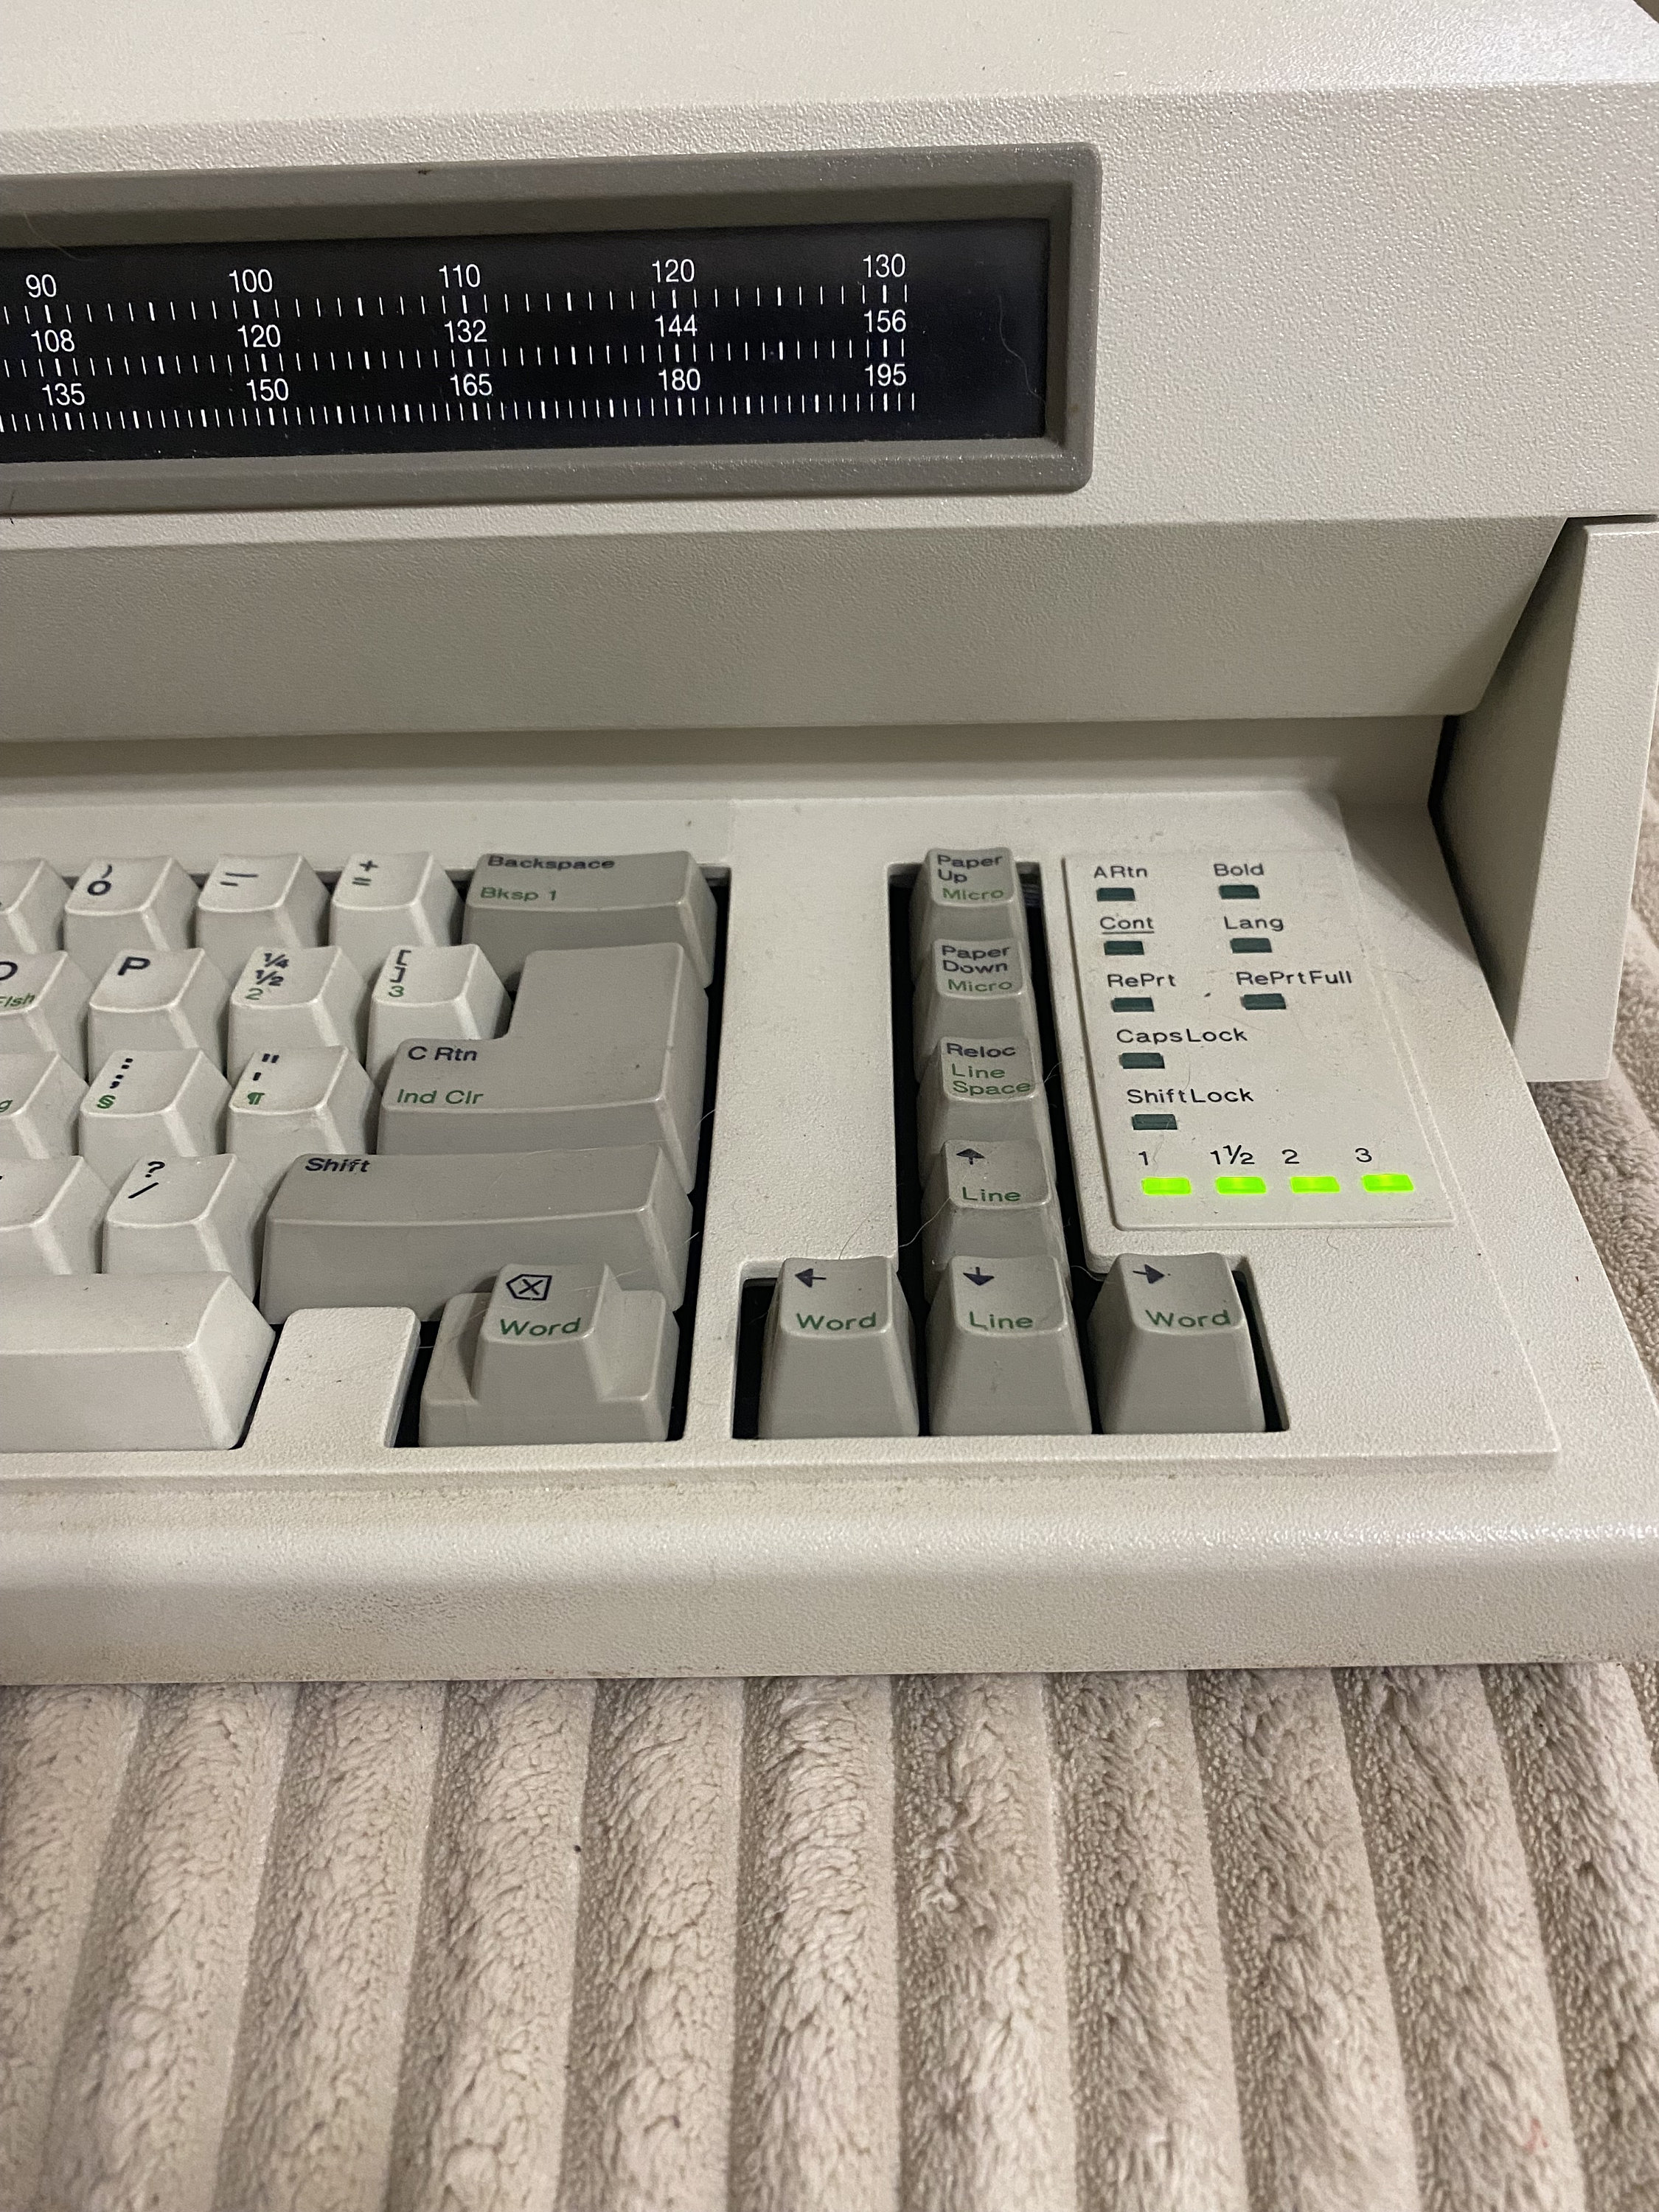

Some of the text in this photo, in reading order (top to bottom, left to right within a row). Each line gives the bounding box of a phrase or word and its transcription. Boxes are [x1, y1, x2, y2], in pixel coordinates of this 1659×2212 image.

[25, 253, 905, 299] 90 100 110 120 130
[30, 309, 907, 353] 108 120 132 144 156
[41, 363, 907, 406] 135 150 165 180 195
[359, 860, 379, 872] +
[487, 854, 615, 871] Backspace
[936, 854, 1003, 870] Paper
[1213, 863, 1265, 877] Bold
[937, 868, 968, 884] Up
[480, 886, 557, 902] Bksp 1
[942, 888, 1004, 901] Micro
[1099, 916, 1154, 931] Cont
[1223, 916, 1284, 932] Lang
[395, 949, 412, 967] [
[942, 945, 1011, 962] Paper
[117, 956, 151, 976] P
[942, 959, 1008, 974] Down
[389, 966, 406, 984] ]
[1107, 973, 1176, 988] RePrt
[947, 978, 1013, 992] Micro
[408, 1046, 478, 1062] C Rtn
[946, 1042, 1017, 1058] Reloc
[951, 1062, 1006, 1079] Line
[397, 1088, 484, 1105] Ind Clr
[953, 1080, 1032, 1096] Space
[305, 1157, 371, 1173] Shift
[1138, 1150, 1149, 1166] 1
[1281, 1149, 1300, 1165] 2
[1354, 1147, 1372, 1163] 3
[145, 1161, 166, 1178] ?
[128, 1182, 159, 1199] /
[961, 1186, 1022, 1203] Line
[500, 1317, 582, 1337] Word
[796, 1311, 877, 1332] Word
[969, 1311, 1034, 1331] Line
[1145, 1309, 1231, 1328] Word
